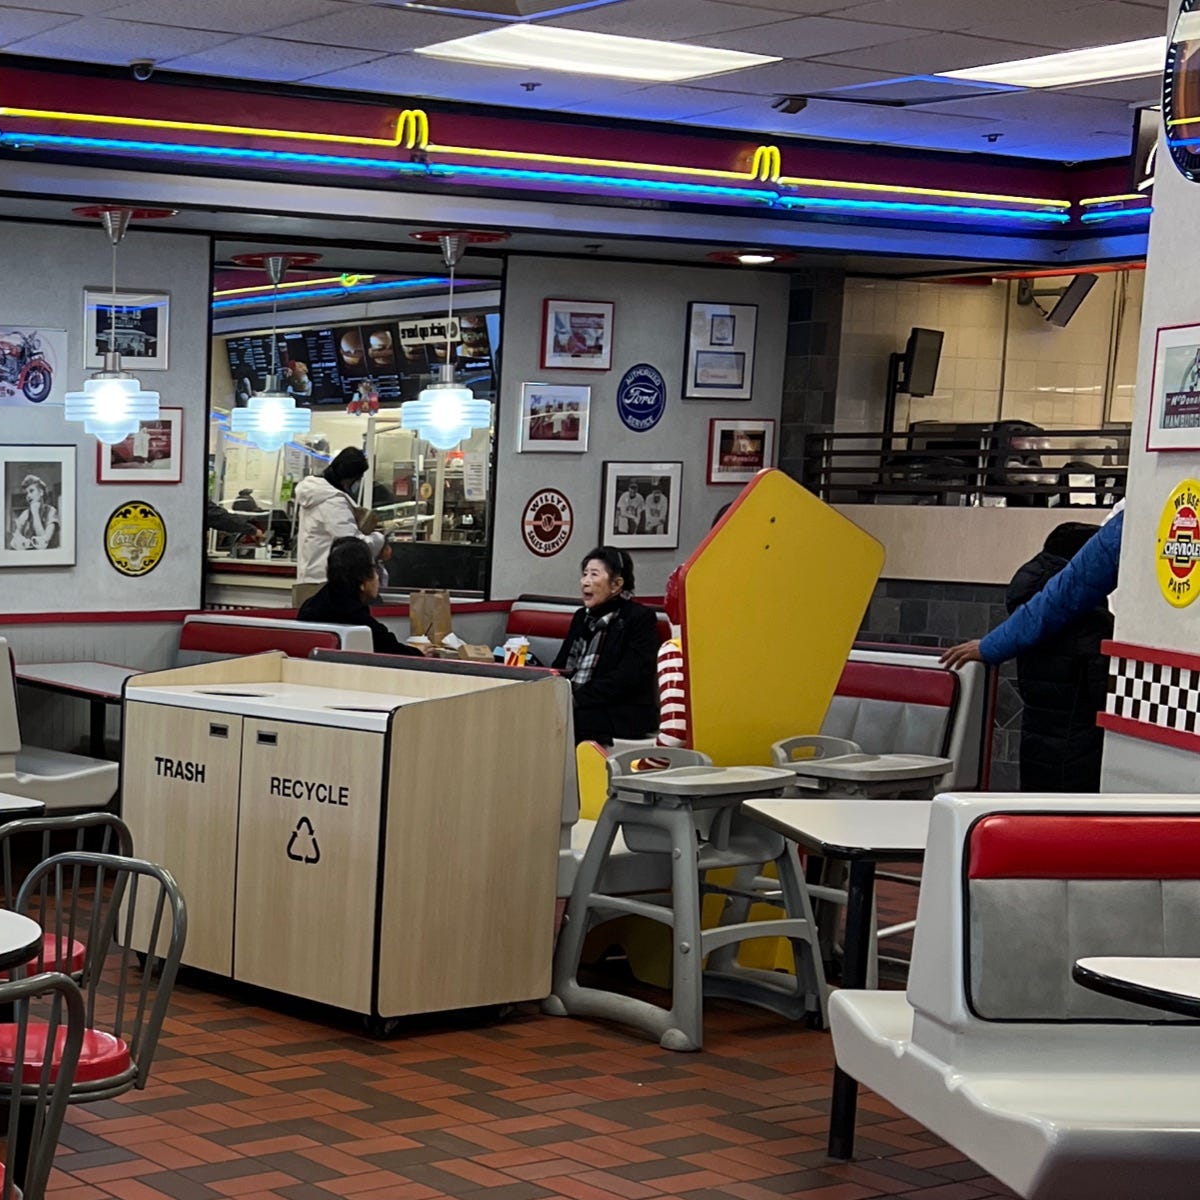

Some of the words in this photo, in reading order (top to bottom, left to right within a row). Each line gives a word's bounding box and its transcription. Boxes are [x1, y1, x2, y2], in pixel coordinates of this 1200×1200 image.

[625, 368, 662, 387] AUTHORIZED
[624, 386, 659, 405] Ford
[627, 415, 655, 430] SERVICE
[530, 494, 568, 512] WILLYS
[1174, 493, 1185, 509] WE
[1167, 577, 1191, 595] PARTS
[154, 756, 206, 783] TRASH
[270, 776, 350, 806] RECYCLE
